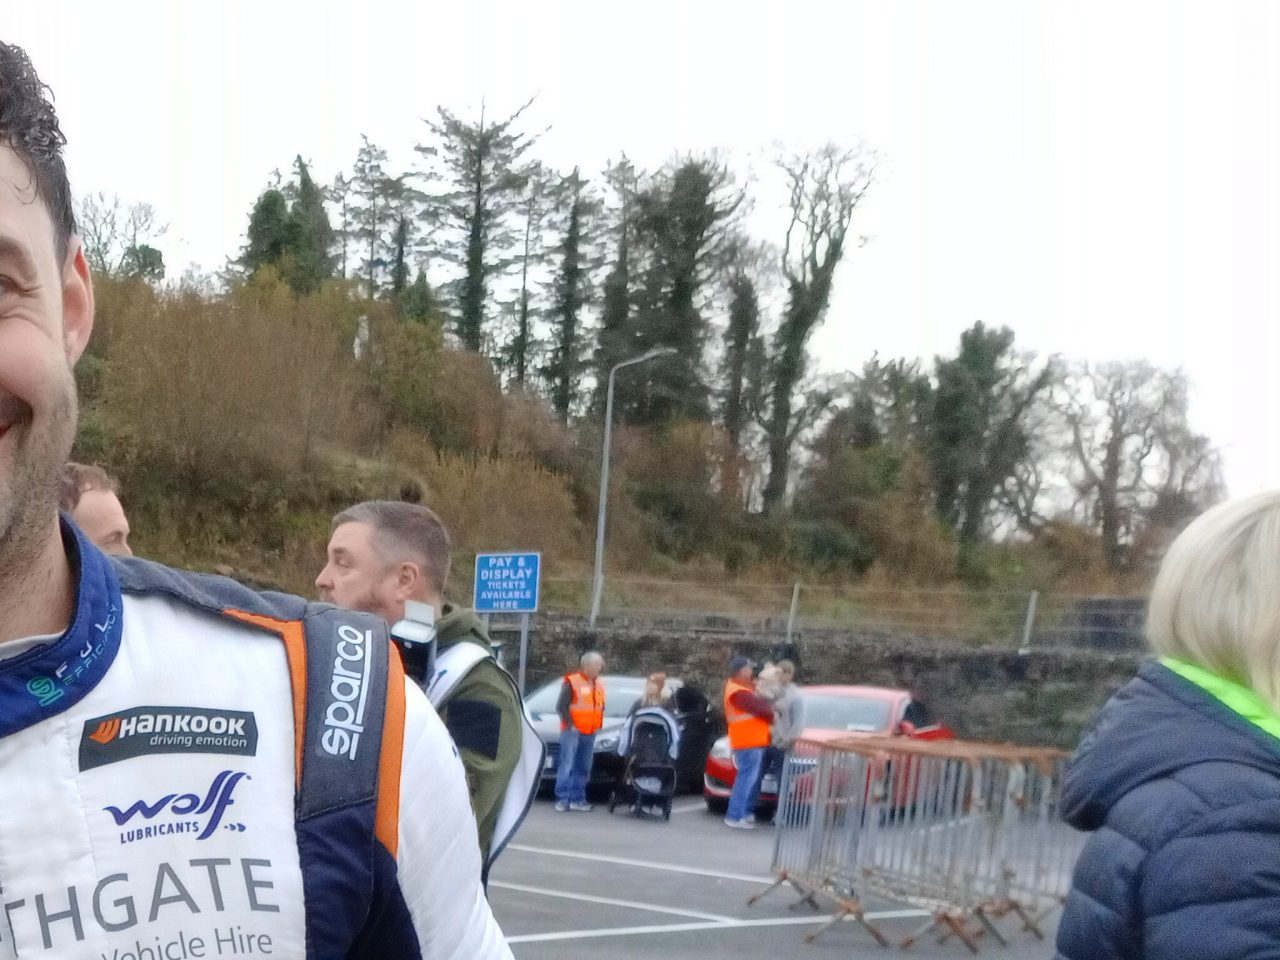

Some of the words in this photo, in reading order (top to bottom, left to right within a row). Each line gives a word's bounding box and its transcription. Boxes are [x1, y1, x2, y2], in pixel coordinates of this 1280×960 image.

[488, 557, 512, 567] PAY
[517, 557, 526, 567] &
[481, 568, 533, 580] DISPLAY
[488, 581, 526, 589] TICKETS
[481, 591, 531, 599] AVAILABLE
[493, 601, 518, 609] HERE
[321, 625, 370, 759] sparco
[150, 735, 192, 747] driving
[195, 735, 247, 748] emotion
[120, 822, 199, 844] LUBRICANTS
[216, 925, 273, 955] Hire
